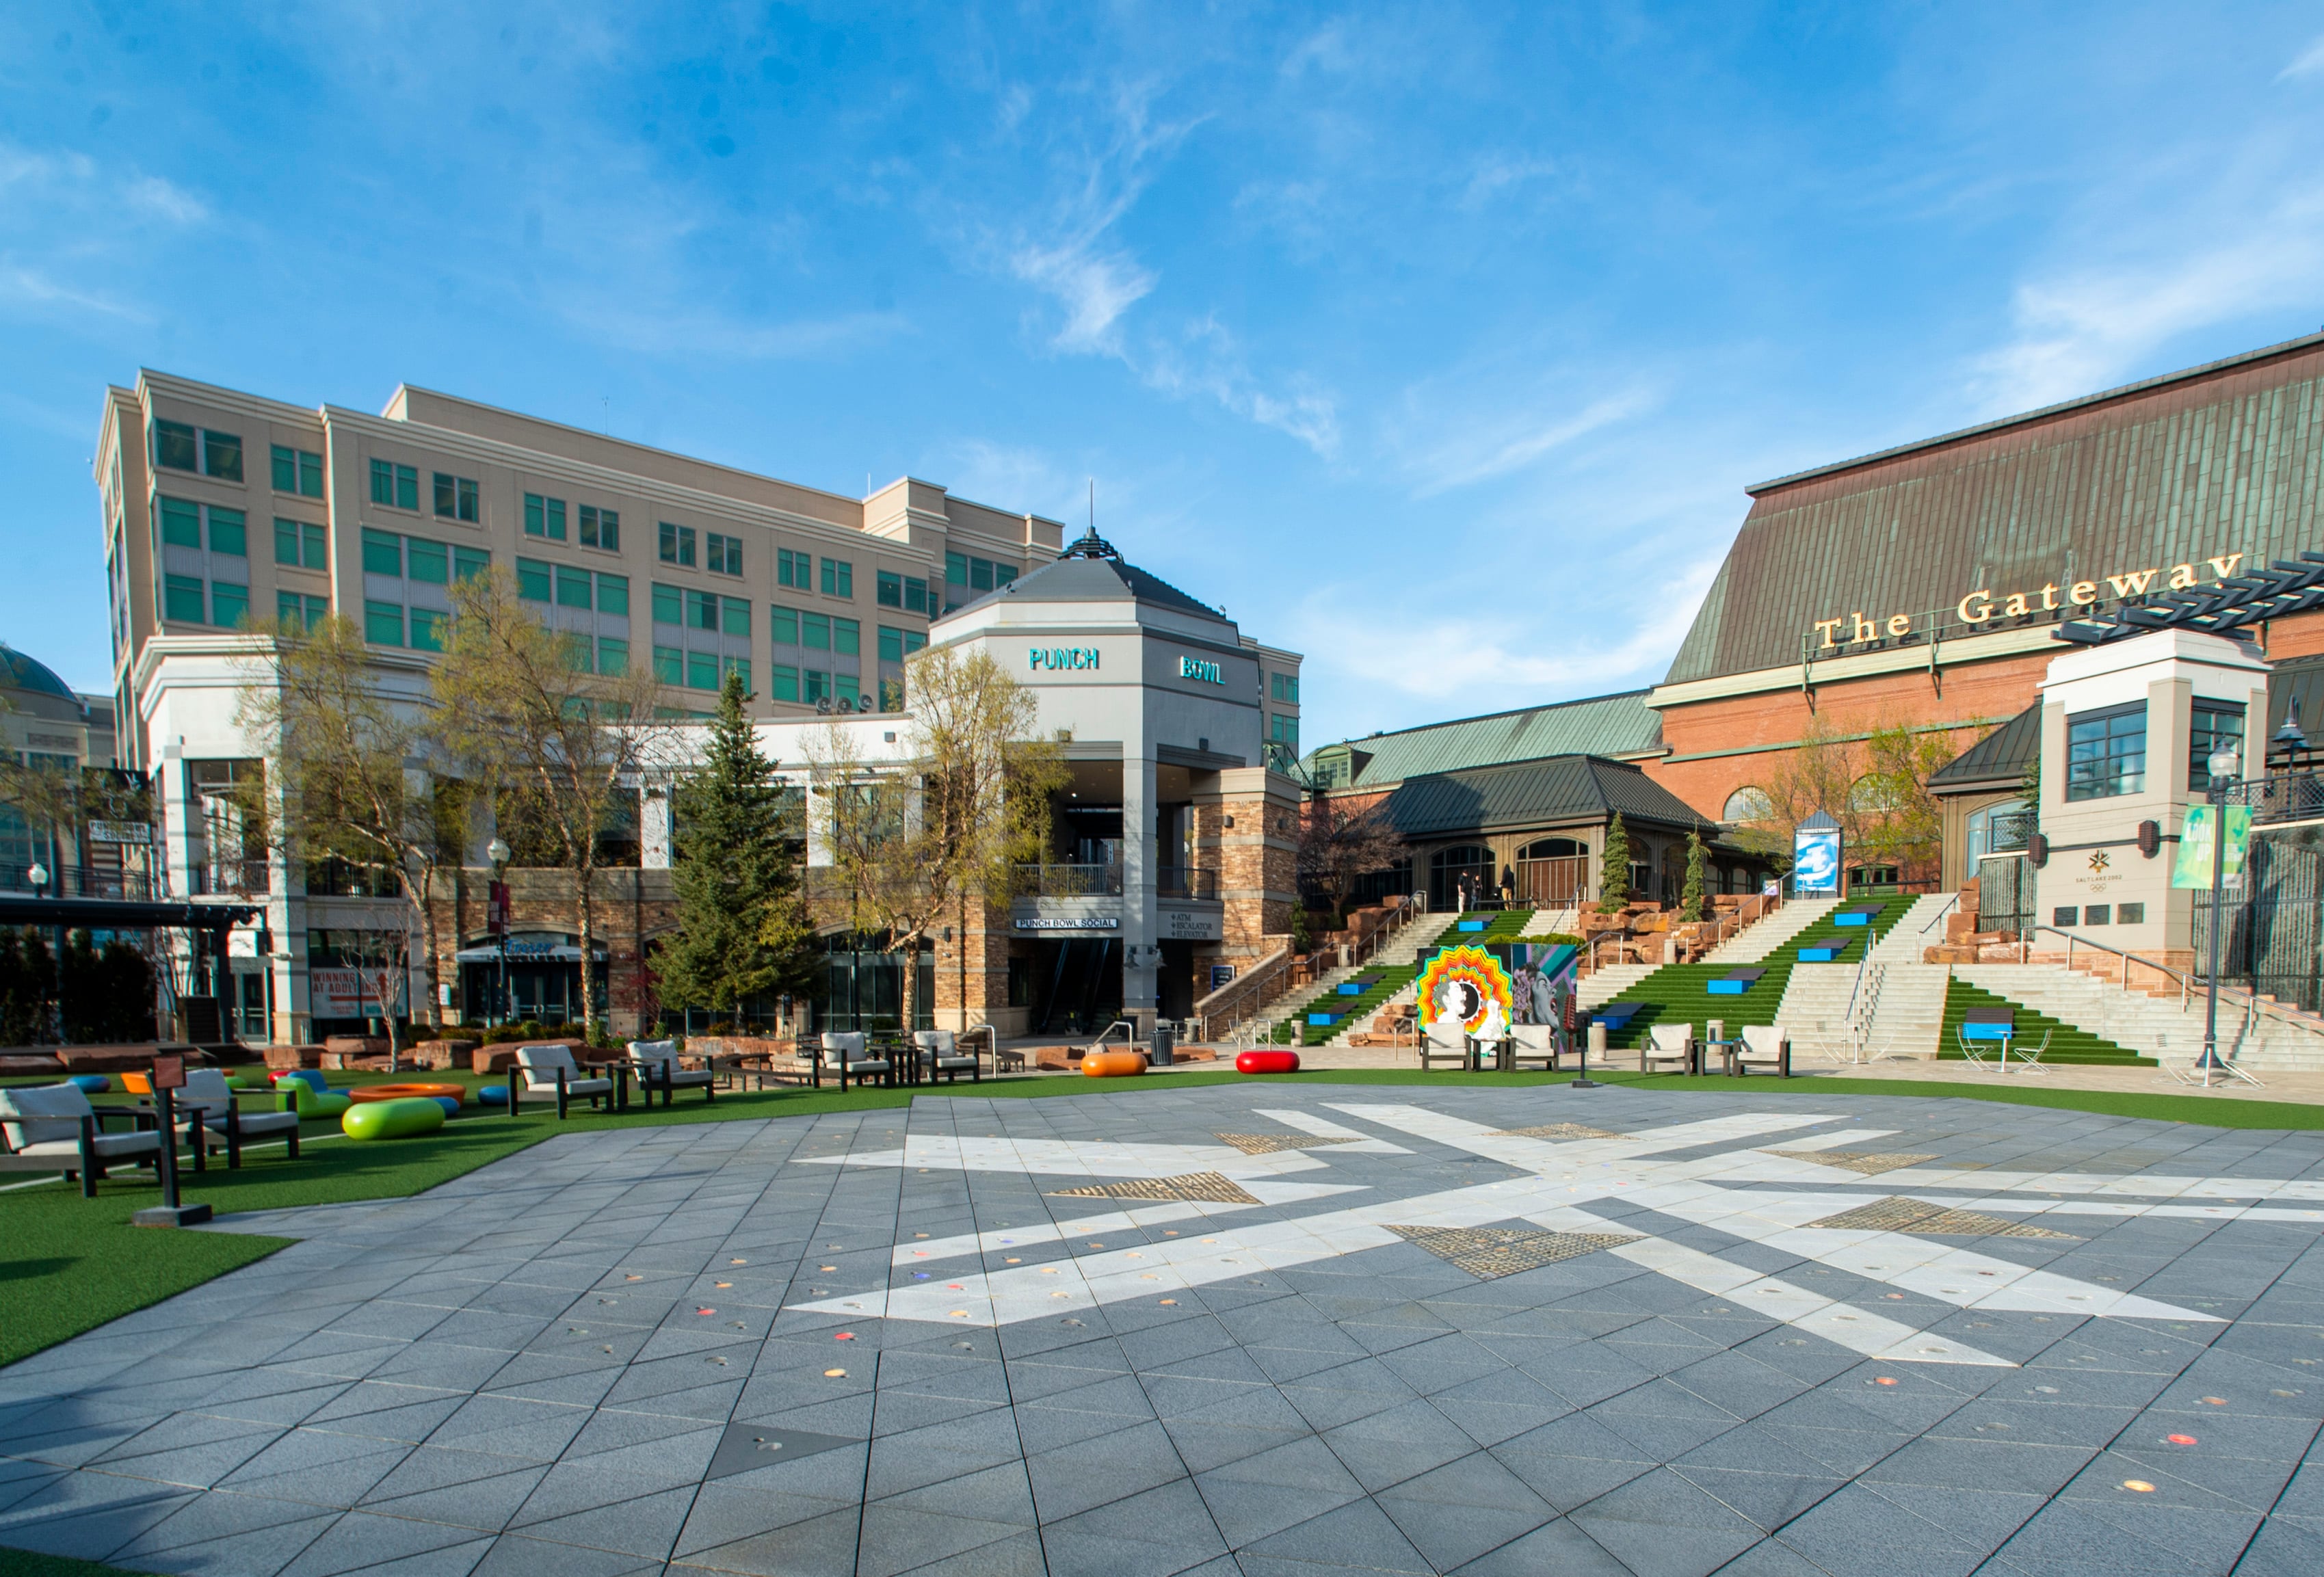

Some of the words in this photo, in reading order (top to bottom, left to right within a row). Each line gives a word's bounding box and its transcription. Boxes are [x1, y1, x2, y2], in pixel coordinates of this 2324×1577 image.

[1814, 612, 1911, 650] The
[1957, 553, 2243, 624] Gateway
[1029, 648, 1100, 670] PUNCH
[1180, 656, 1226, 685] BOWL
[2184, 822, 2212, 842] LOOK
[2196, 843, 2212, 862] UP
[1020, 918, 1051, 927] PUNCH
[1053, 918, 1079, 927] BOWL
[1081, 918, 1114, 927] SOCIAL
[1176, 913, 1191, 921] ATM
[1176, 922, 1213, 931] ESCALATOR
[1176, 930, 1209, 939] ELEVATOR
[313, 972, 356, 983] WINNING
[313, 983, 324, 993] AT
